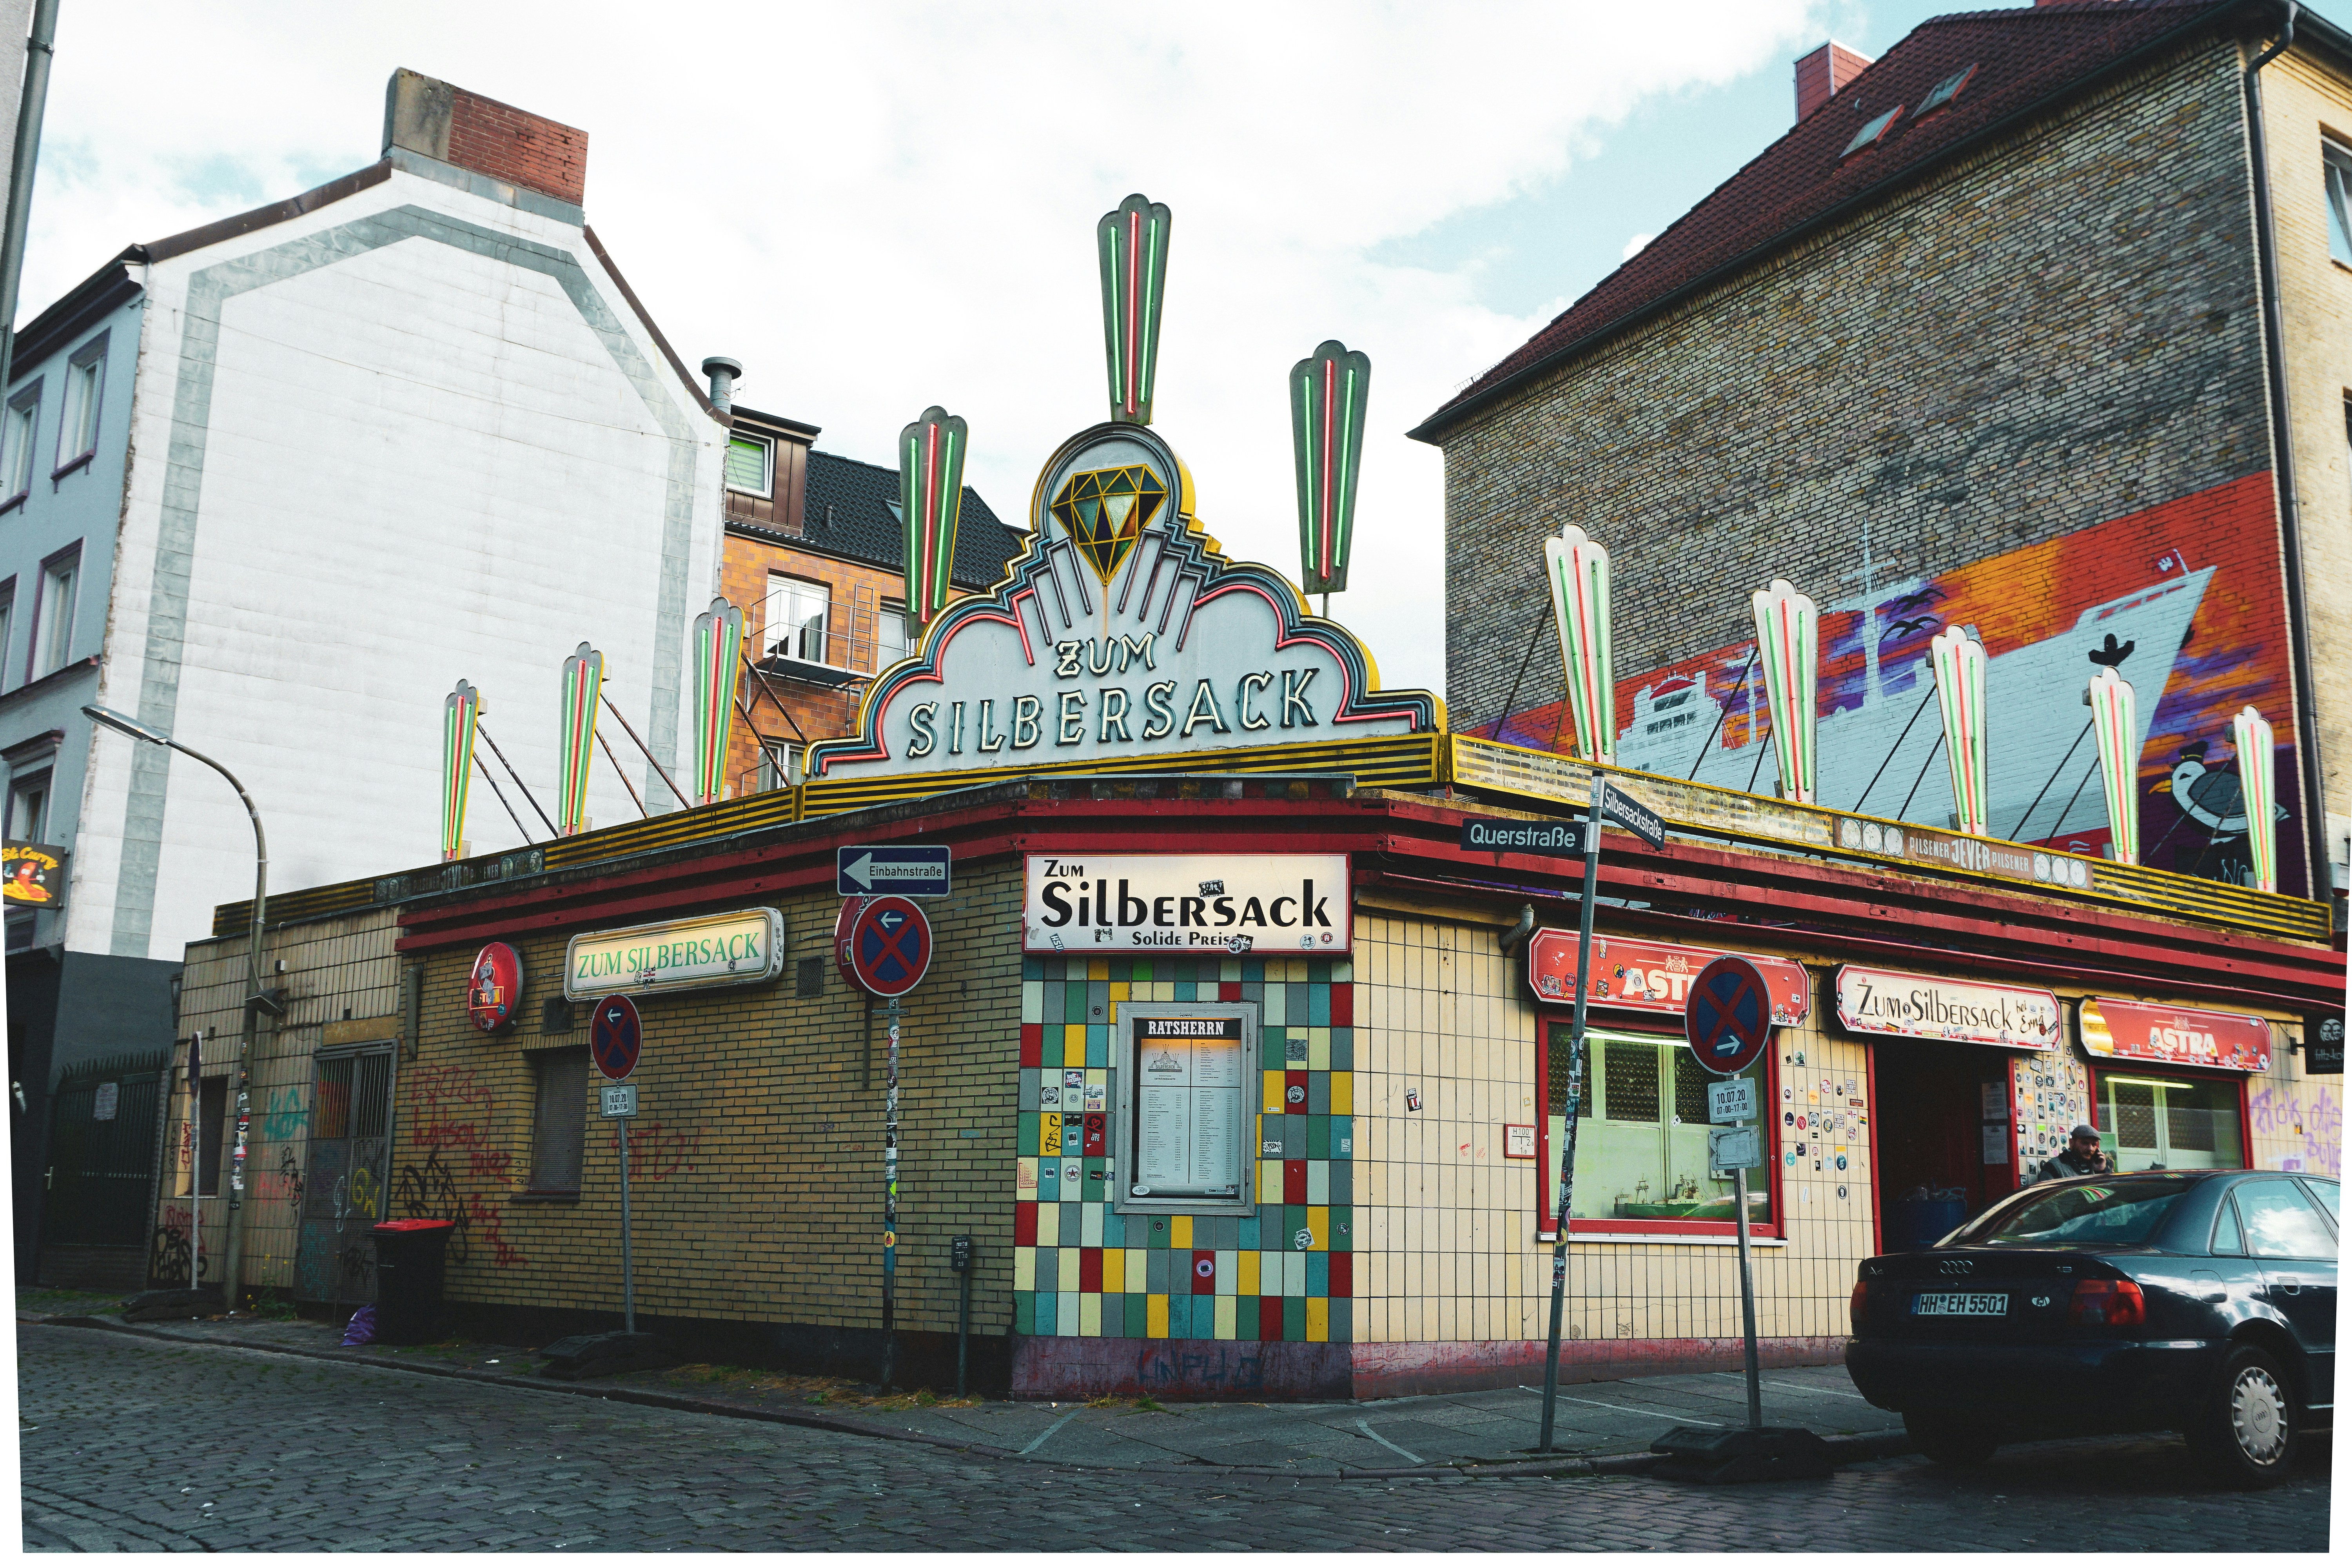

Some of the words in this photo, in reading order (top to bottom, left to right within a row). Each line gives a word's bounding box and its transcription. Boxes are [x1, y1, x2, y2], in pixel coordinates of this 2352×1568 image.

[1054, 632, 1156, 679] ZUM
[906, 668, 1319, 758] SILBERSACK
[1605, 789, 1662, 841] Silbersackstraße
[1470, 824, 1575, 847] Querstraße
[1909, 837, 1949, 859] PILSENER
[1951, 839, 1990, 871] JEVER
[1992, 852, 2029, 872] PILSENER
[870, 866, 942, 877] Einbahnstraße
[577, 950, 621, 979] ZUM
[626, 932, 760, 973] SILBERSACK
[1623, 968, 1690, 1002] AST
[2016, 1000, 2027, 1014] bei
[1148, 1021, 1224, 1035] RATSHERRN
[2149, 1027, 2219, 1058] ASTRA
[609, 1093, 626, 1103] 10.07.20
[1717, 1089, 1746, 1104] 10.07.20
[1717, 1102, 1748, 1115] 07:00-17:00
[1920, 1295, 1938, 1313] HH
[1947, 1295, 1967, 1313] EH
[1968, 1295, 2007, 1314] 5501
